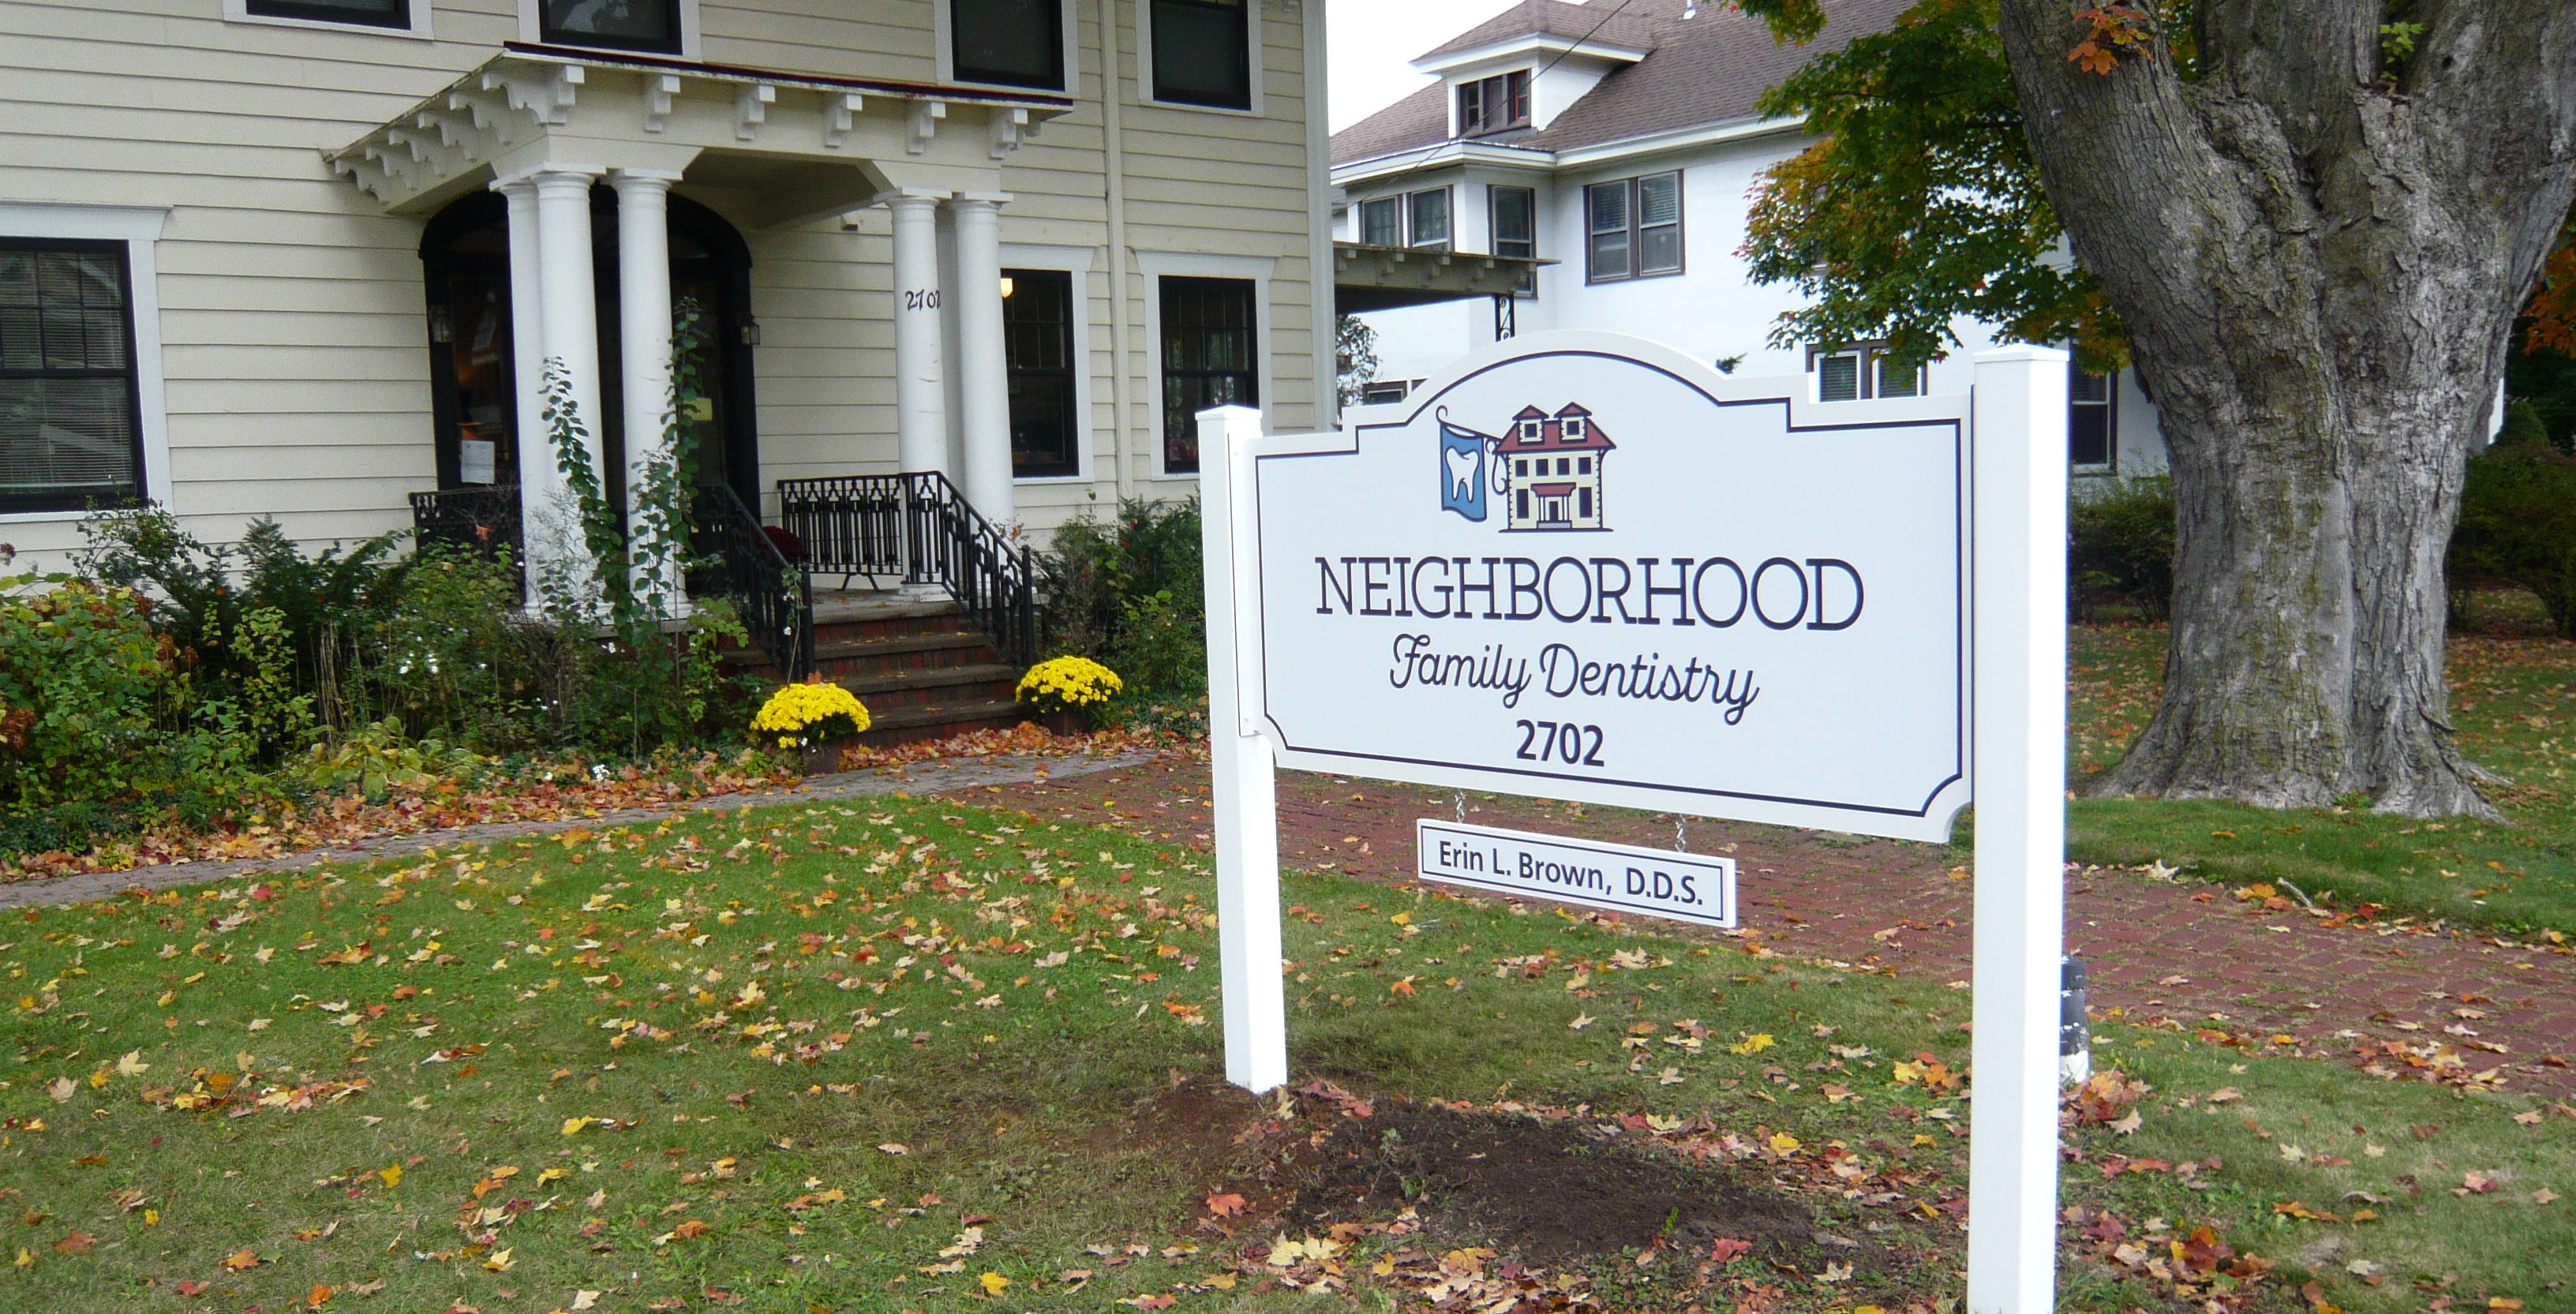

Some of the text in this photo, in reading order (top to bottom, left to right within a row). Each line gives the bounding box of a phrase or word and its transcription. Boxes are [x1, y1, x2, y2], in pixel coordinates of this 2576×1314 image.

[1314, 556, 1864, 631] NEIGHBORHOOD
[1390, 633, 1760, 726] Family Dentistry
[1516, 719, 1604, 767] 2702
[1440, 840, 1703, 906] Erin L. Brown, D.D.S.
